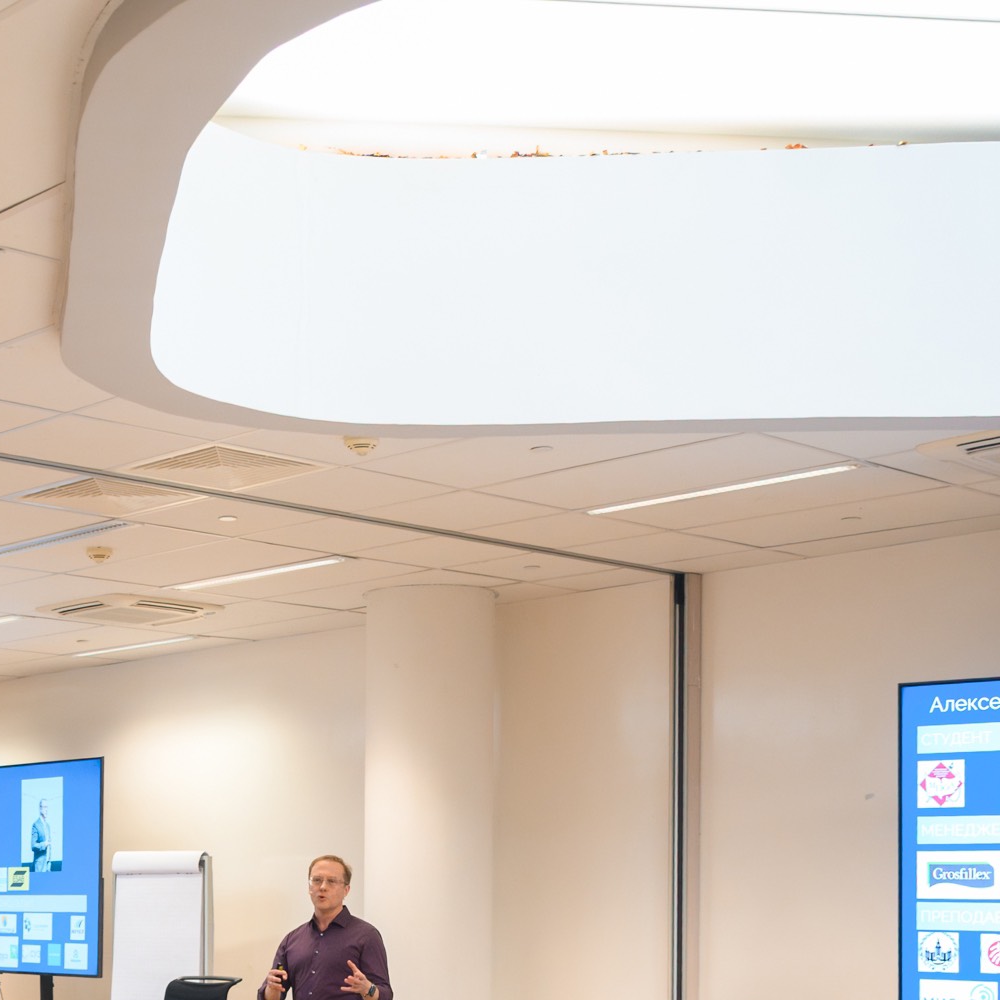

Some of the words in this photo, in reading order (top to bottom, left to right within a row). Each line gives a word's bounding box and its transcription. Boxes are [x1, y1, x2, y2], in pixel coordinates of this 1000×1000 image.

[929, 696, 1000, 713] Алексе
[921, 730, 992, 747] СТУДЕНТ
[921, 823, 1000, 838] МЕНЕДЖЕ
[932, 867, 992, 880] Grosfillex
